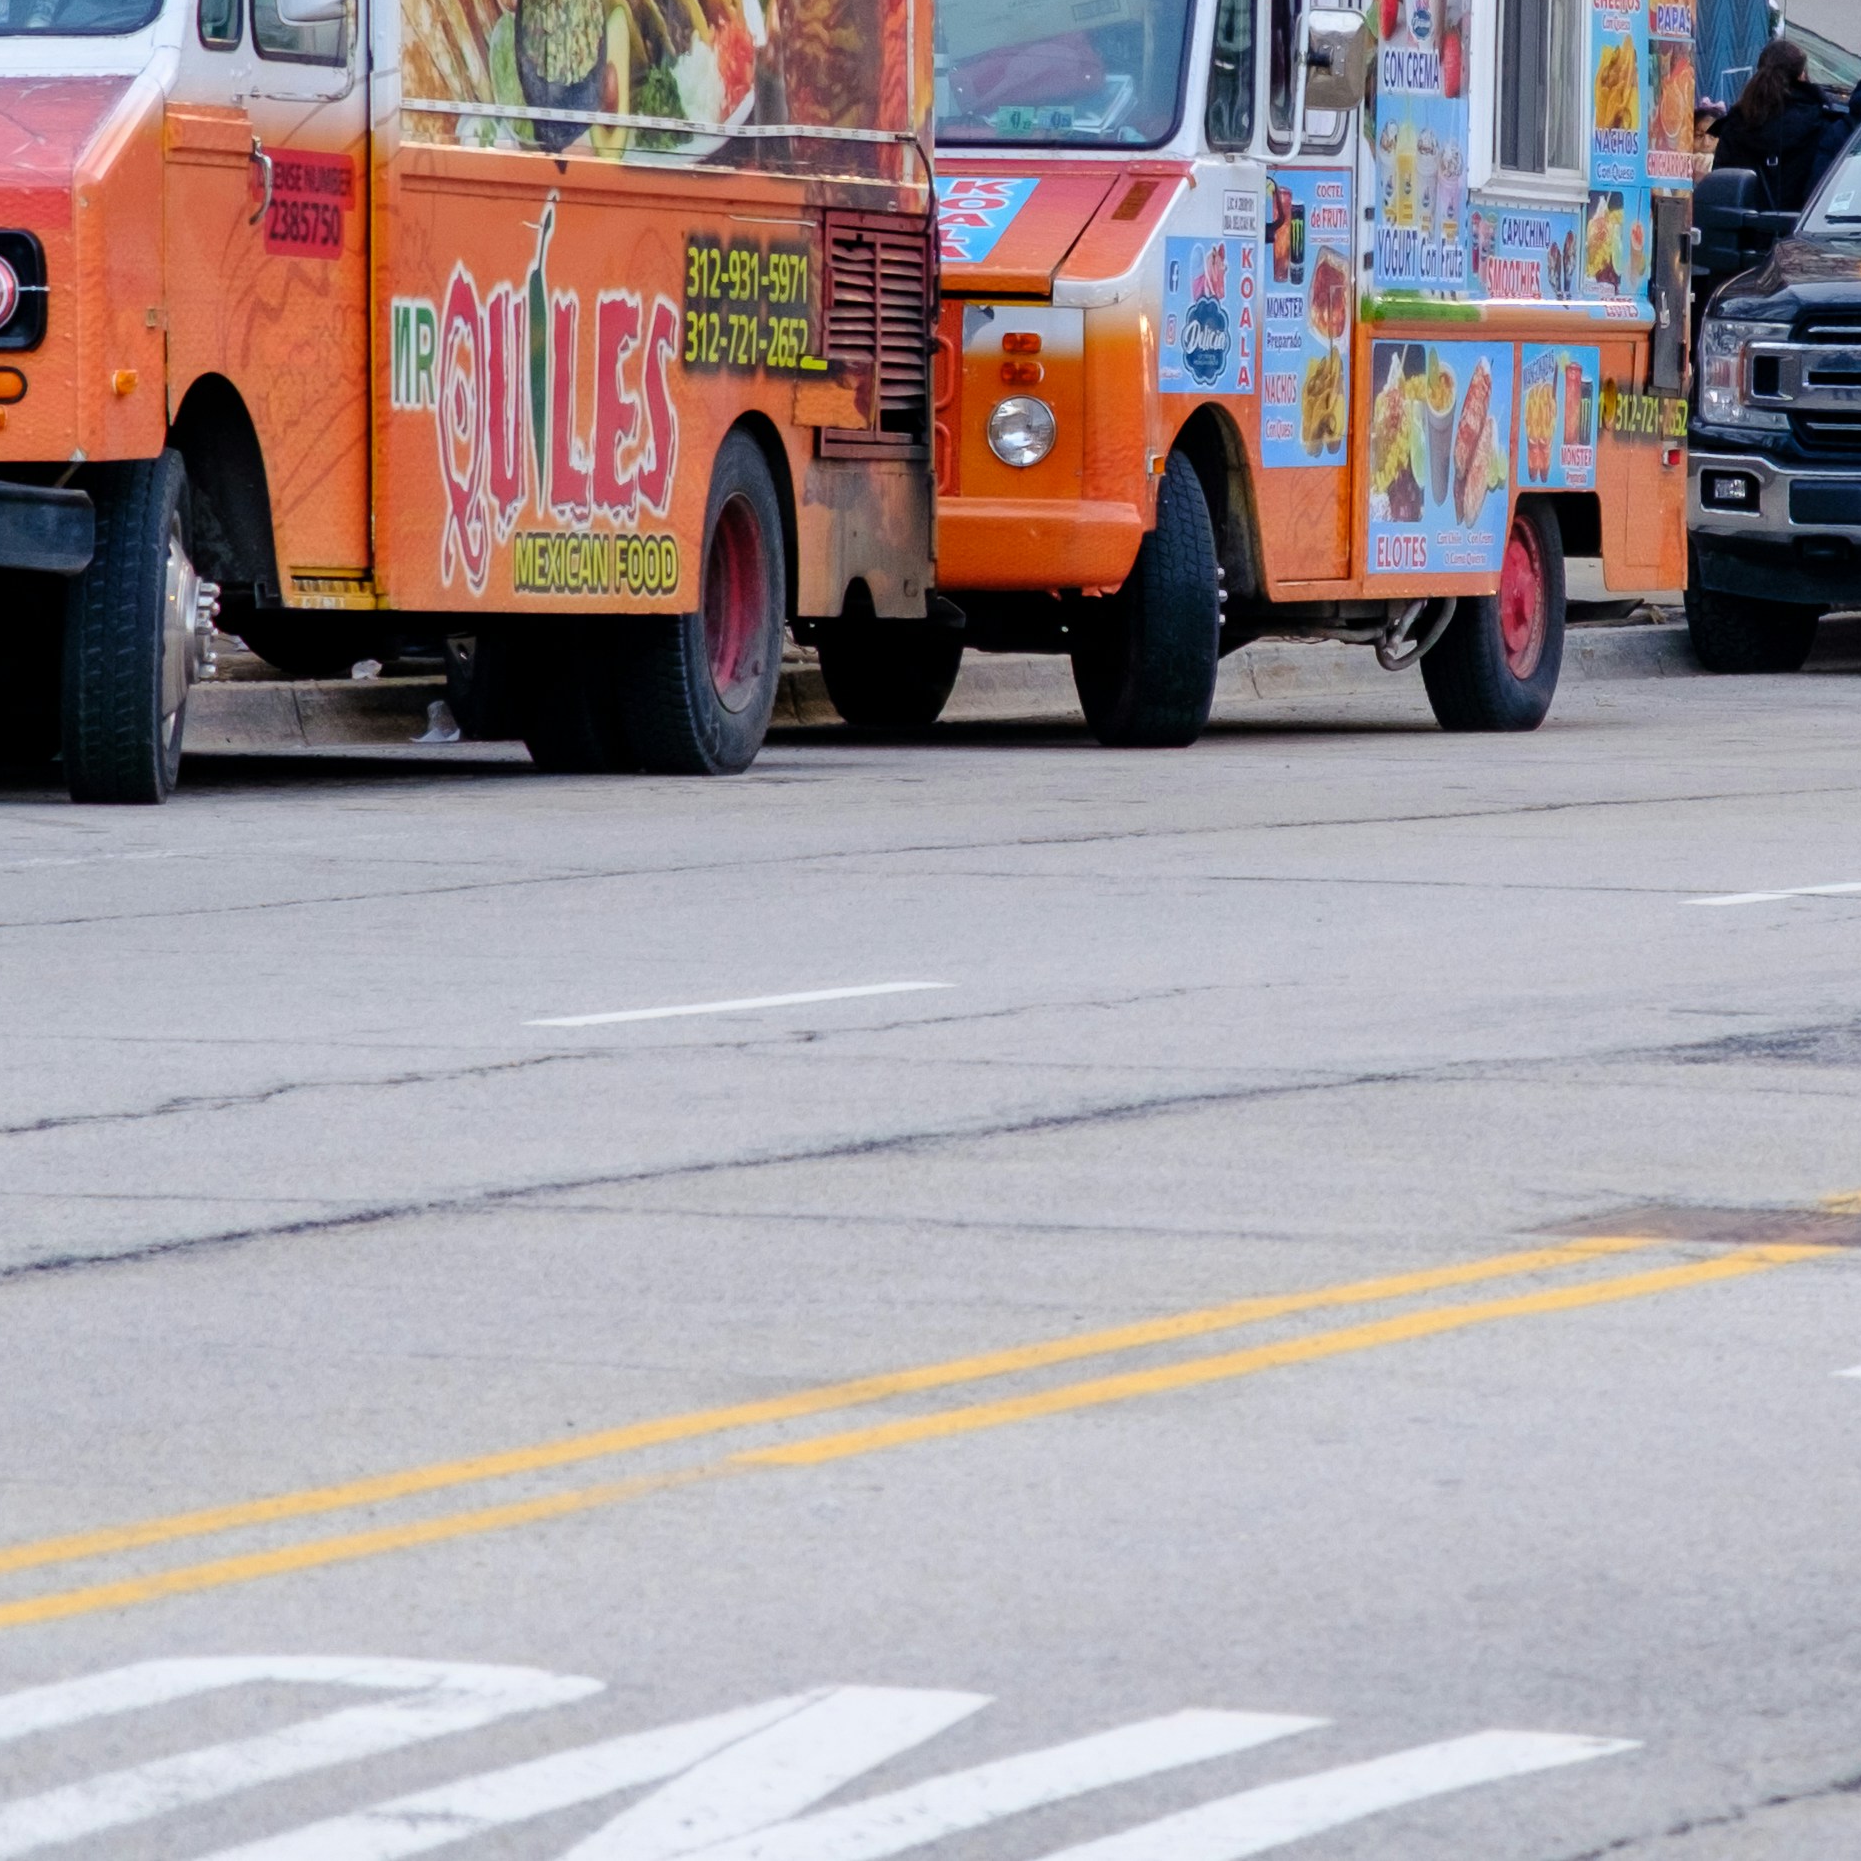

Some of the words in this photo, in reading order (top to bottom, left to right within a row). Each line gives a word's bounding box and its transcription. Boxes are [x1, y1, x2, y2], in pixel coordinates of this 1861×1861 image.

[1657, 5, 1692, 33] PAPAS
[1383, 52, 1405, 92] CON
[1405, 49, 1440, 90] CREMA
[1593, 130, 1639, 156] NACHOS
[1316, 184, 1344, 198] COCTEL
[1321, 208, 1349, 229] FRUTA
[1501, 217, 1552, 250] CAPUCHINO
[1376, 229, 1419, 280] YOGURT
[686, 245, 809, 305] 312-931-5971
[1488, 257, 1543, 300] SMOOTHIES
[1237, 245, 1256, 388] KOALA
[1266, 296, 1304, 319] MONSTER
[685, 310, 828, 371] 312-721-2652
[1264, 373, 1297, 405] NACHOS
[514, 534, 610, 591] MEXICAN
[616, 535, 680, 592] FOOD
[1377, 535, 1427, 568] ELOTES
